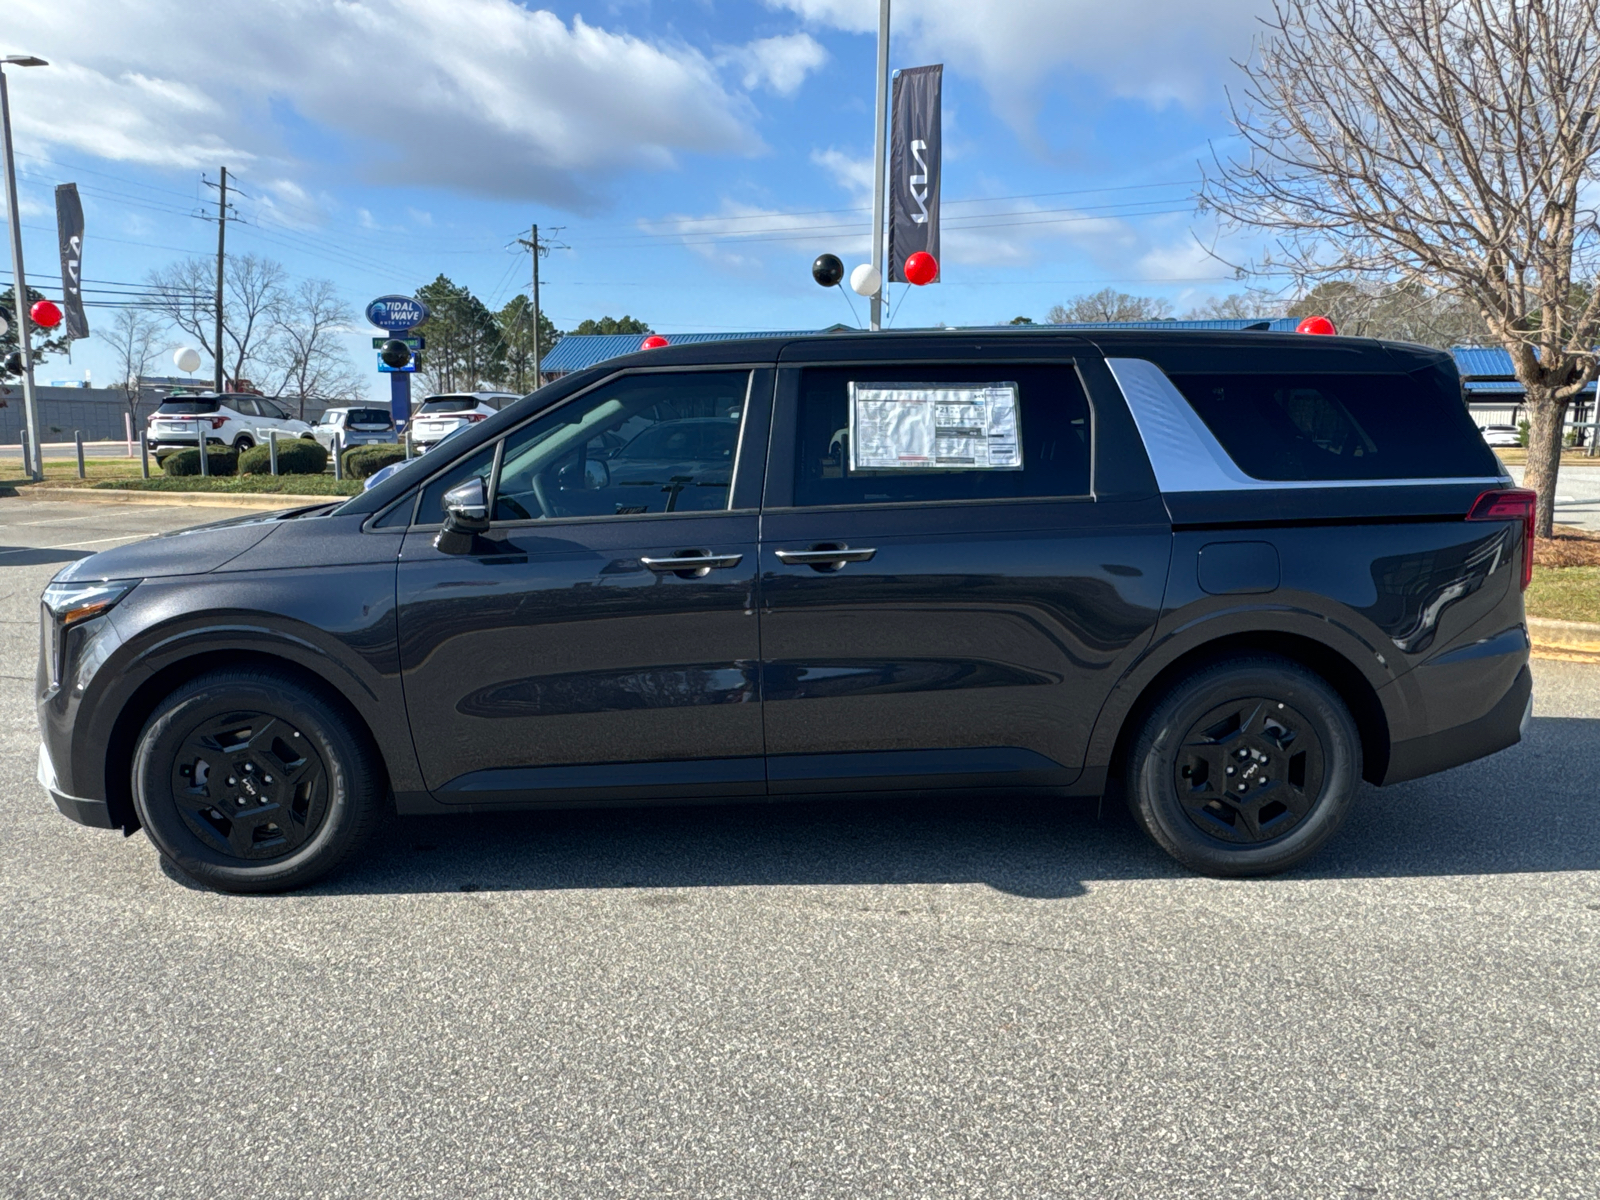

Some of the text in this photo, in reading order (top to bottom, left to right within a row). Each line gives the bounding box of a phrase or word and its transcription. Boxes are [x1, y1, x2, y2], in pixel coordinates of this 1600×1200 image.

[910, 139, 929, 224] KIA
[386, 302, 414, 311] TIDAL
[391, 311, 419, 320] WAVE
